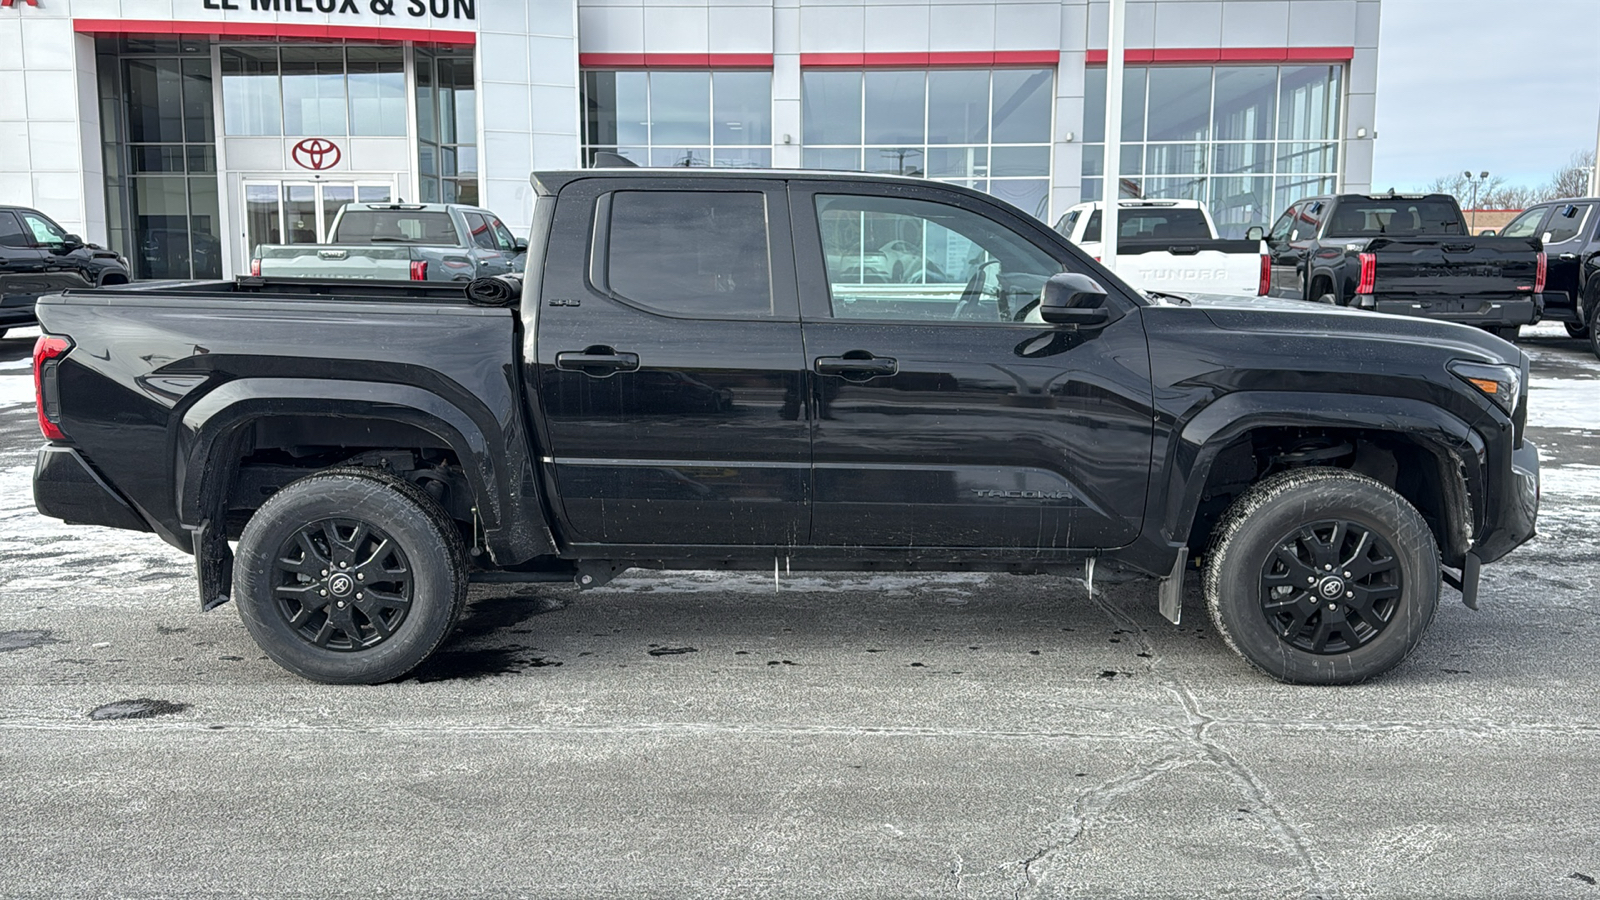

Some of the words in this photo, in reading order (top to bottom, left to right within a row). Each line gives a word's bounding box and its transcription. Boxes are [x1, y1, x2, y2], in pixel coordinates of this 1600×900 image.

[369, 0, 396, 16] &
[1138, 268, 1229, 280] TUNDRA
[971, 488, 1073, 500] TACOMA
